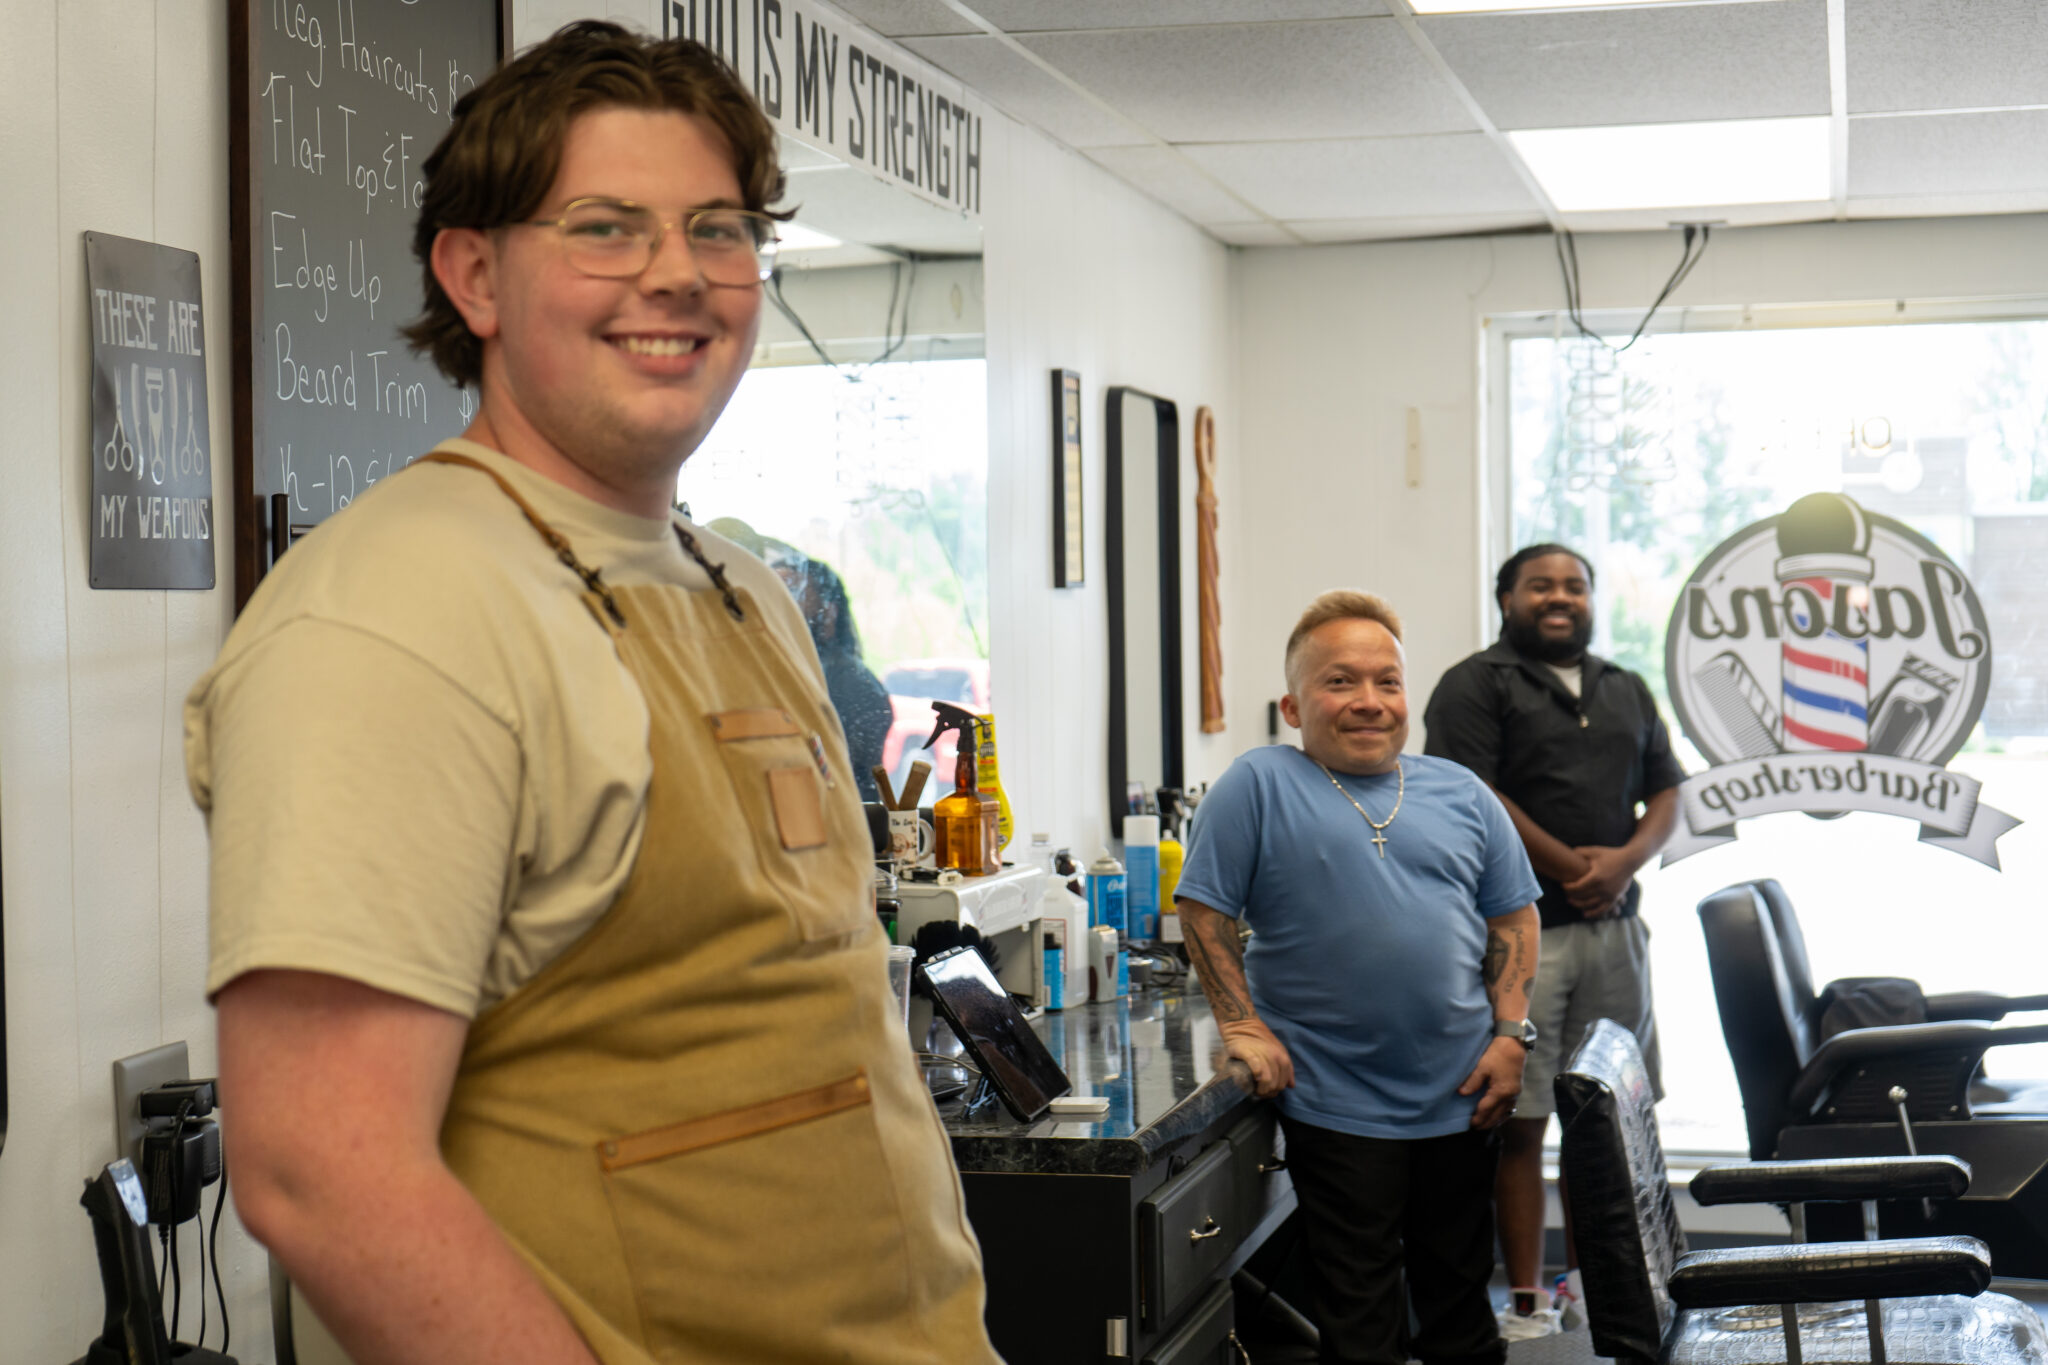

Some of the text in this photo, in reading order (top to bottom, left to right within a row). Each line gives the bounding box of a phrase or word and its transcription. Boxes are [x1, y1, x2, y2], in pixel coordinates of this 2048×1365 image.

[338, 0, 437, 114] Haircuts
[753, 0, 782, 120] IS
[795, 10, 838, 144] MY
[849, 44, 981, 215] STRENGTH
[261, 71, 326, 176] Flat
[271, 211, 381, 322] Edge Up
[95, 288, 201, 356] THESE ARE
[275, 322, 357, 411] Beard
[367, 350, 427, 424] Trim
[101, 495, 209, 540] MY WEAPONS
